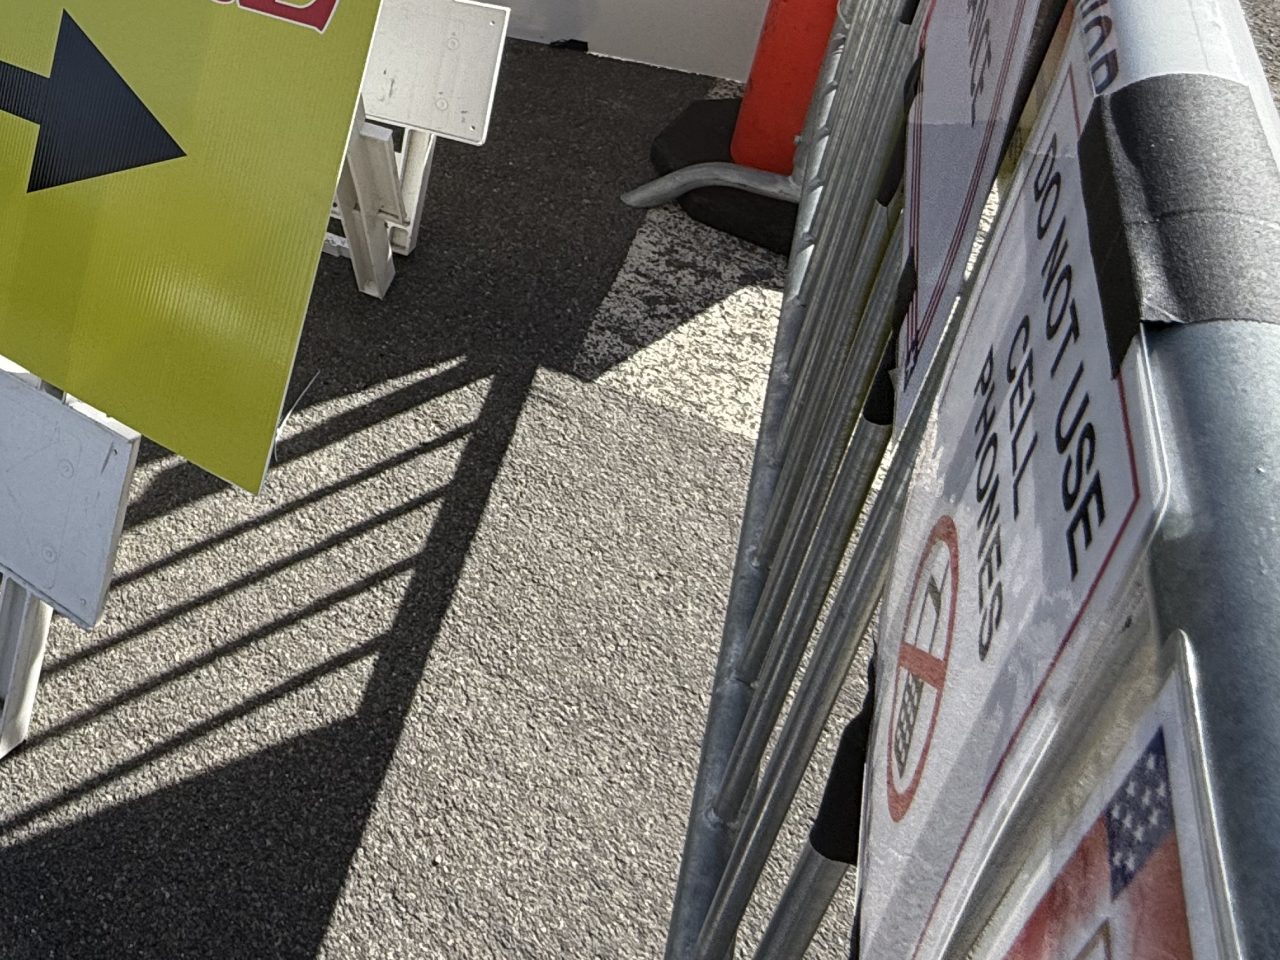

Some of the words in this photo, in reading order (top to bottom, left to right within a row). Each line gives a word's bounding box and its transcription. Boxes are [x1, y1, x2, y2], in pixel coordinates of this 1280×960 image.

[1034, 131, 1061, 241] DO
[1042, 215, 1079, 380] NOT
[973, 342, 1004, 664] PHONES
[1006, 313, 1038, 523] CELL
[1054, 358, 1106, 584] USE
